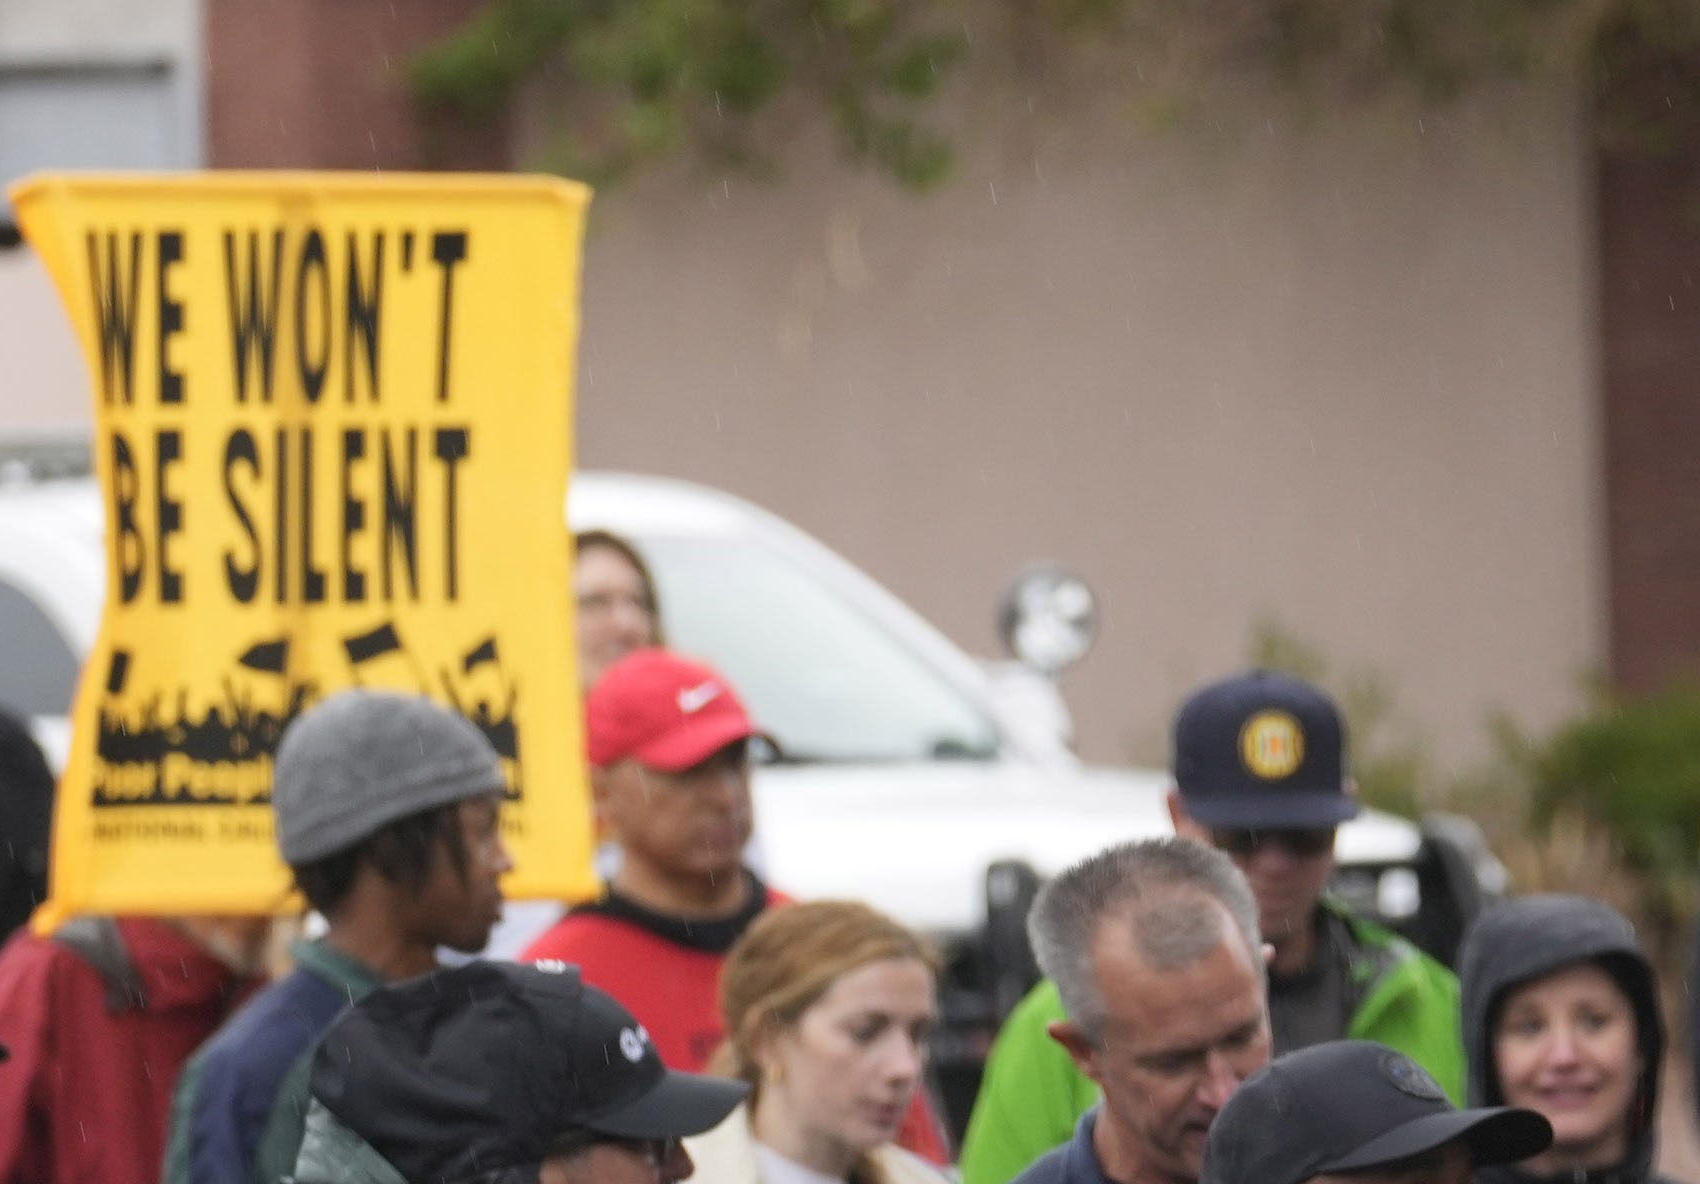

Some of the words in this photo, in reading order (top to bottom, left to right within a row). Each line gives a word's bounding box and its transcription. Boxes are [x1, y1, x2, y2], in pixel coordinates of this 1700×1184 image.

[87, 228, 185, 405] WE
[224, 227, 469, 404] WON'T
[111, 427, 186, 606] BE
[222, 426, 471, 606] SILENT
